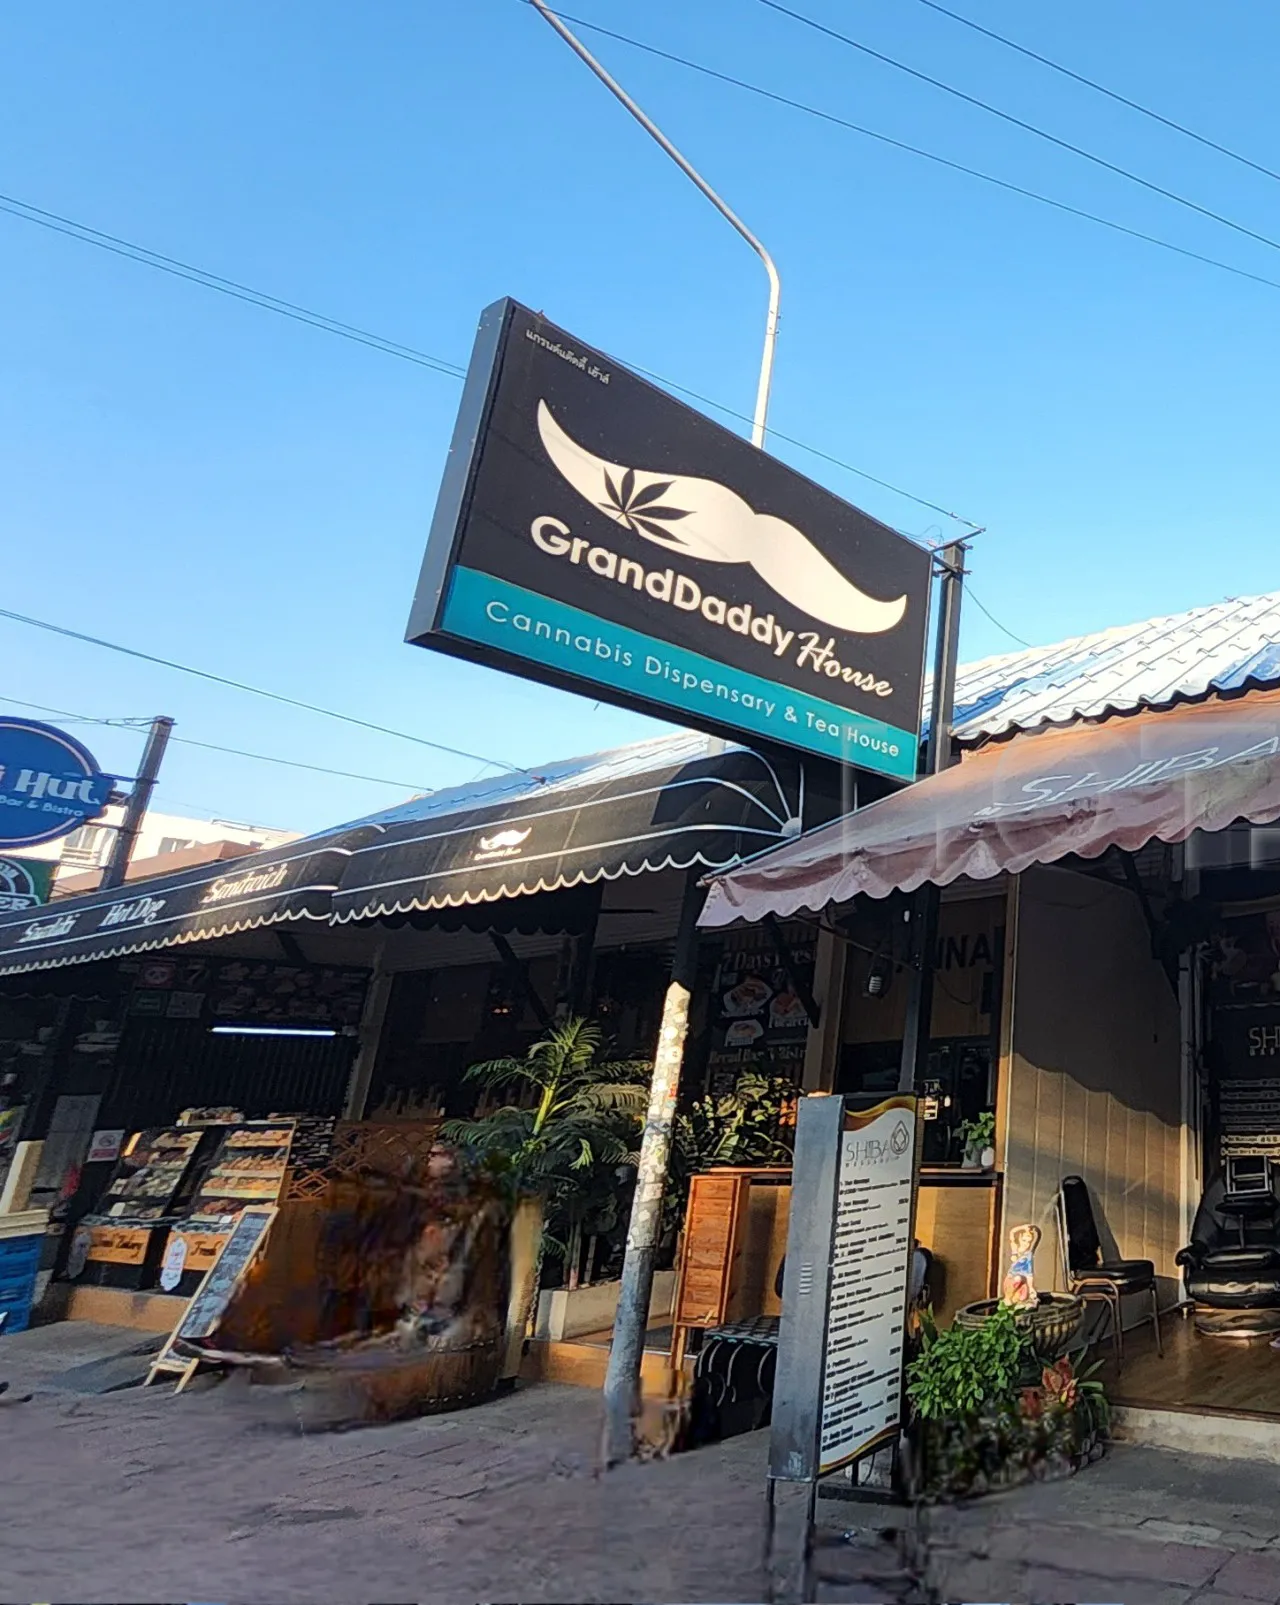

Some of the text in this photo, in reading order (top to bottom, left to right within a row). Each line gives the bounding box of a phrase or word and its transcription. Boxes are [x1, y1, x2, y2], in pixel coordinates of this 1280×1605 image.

[531, 515, 893, 696] GrandDaddy House
[486, 601, 900, 757] Cannabis Dispensary & Tea House
[14, 769, 101, 805] Hut
[994, 736, 1280, 807] SHIBA
[42, 802, 85, 818] Bistro
[99, 898, 166, 926] Hot Dog
[845, 1139, 889, 1162] SHIBA
